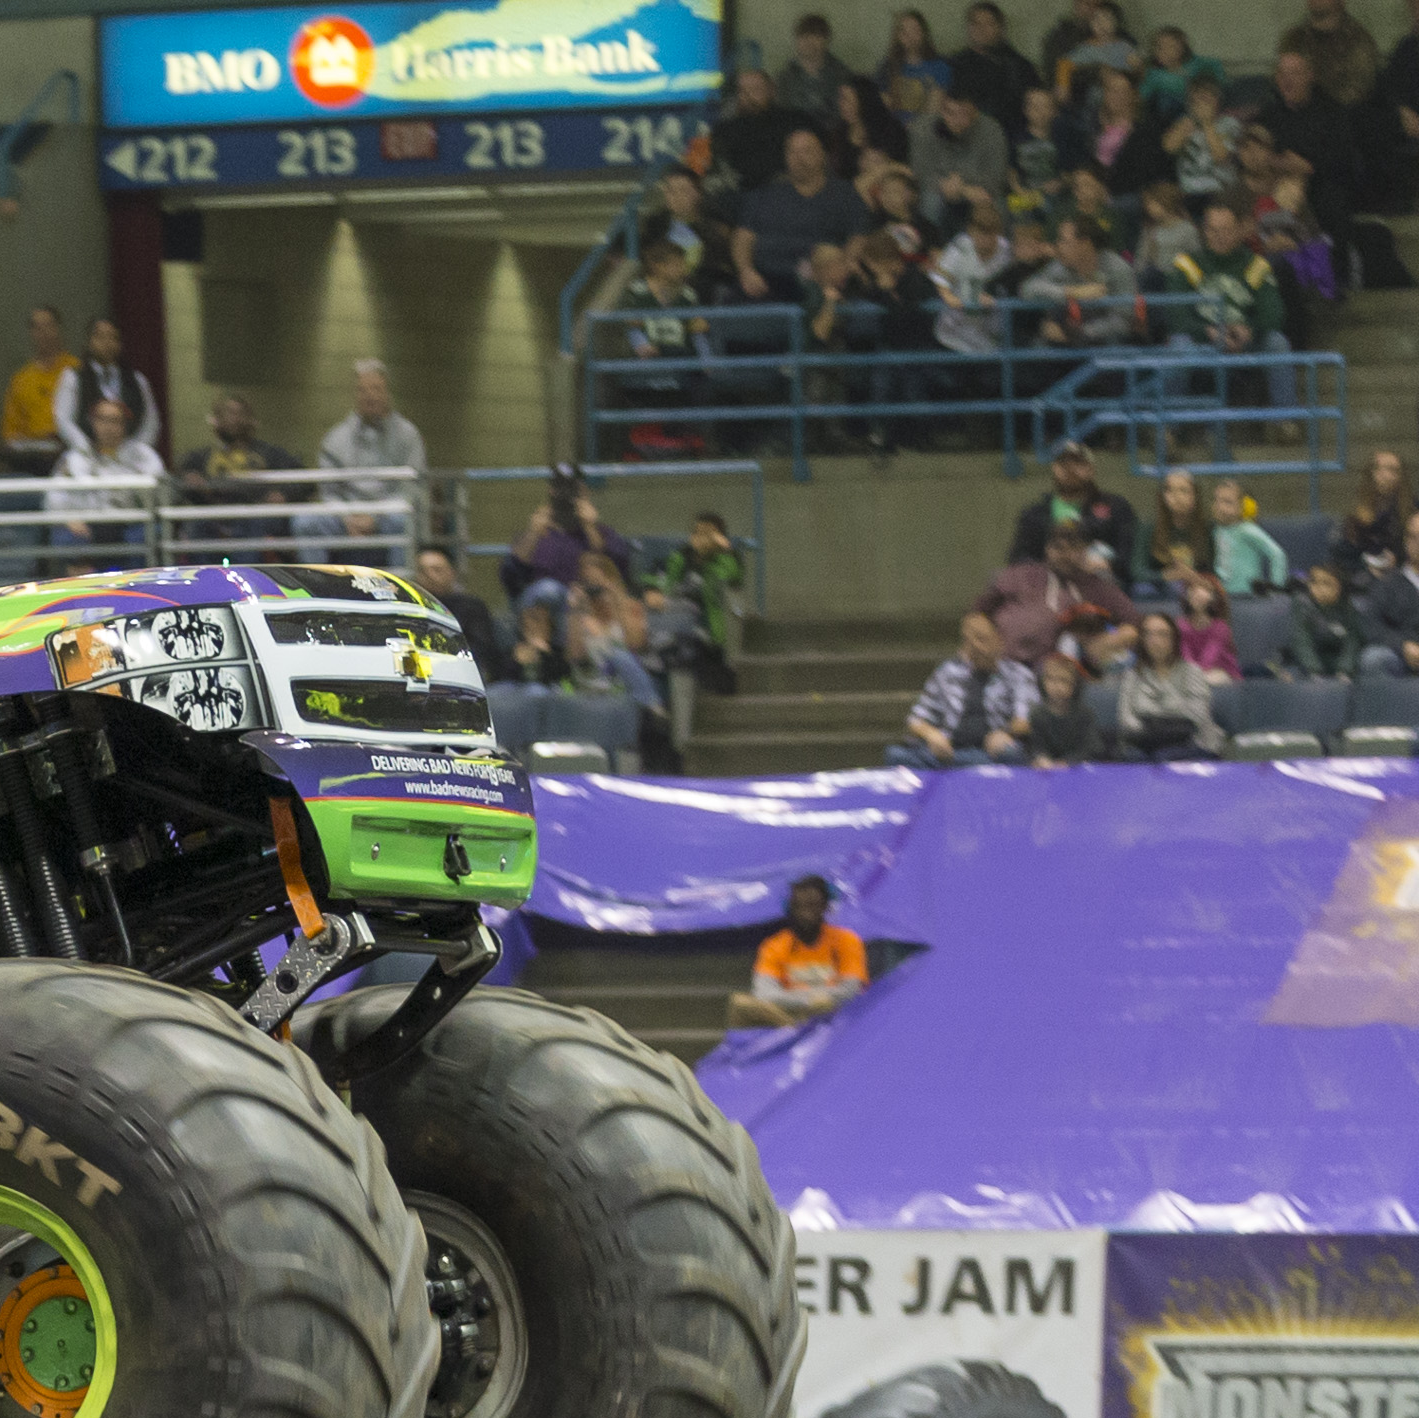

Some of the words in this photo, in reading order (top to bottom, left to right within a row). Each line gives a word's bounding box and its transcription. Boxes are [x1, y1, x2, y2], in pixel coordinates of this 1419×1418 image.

[163, 47, 281, 96] BMO
[390, 38, 535, 84] Harris
[542, 29, 661, 76] Bank
[135, 136, 219, 183] 212
[277, 129, 358, 177] 213
[464, 121, 546, 169] 213
[371, 755, 429, 773] DELIVERING
[430, 758, 451, 774] BAD
[452, 760, 475, 777] NEWS
[405, 780, 504, 804] www.badnewsracing.com
[901, 1256, 1077, 1317] JAM
